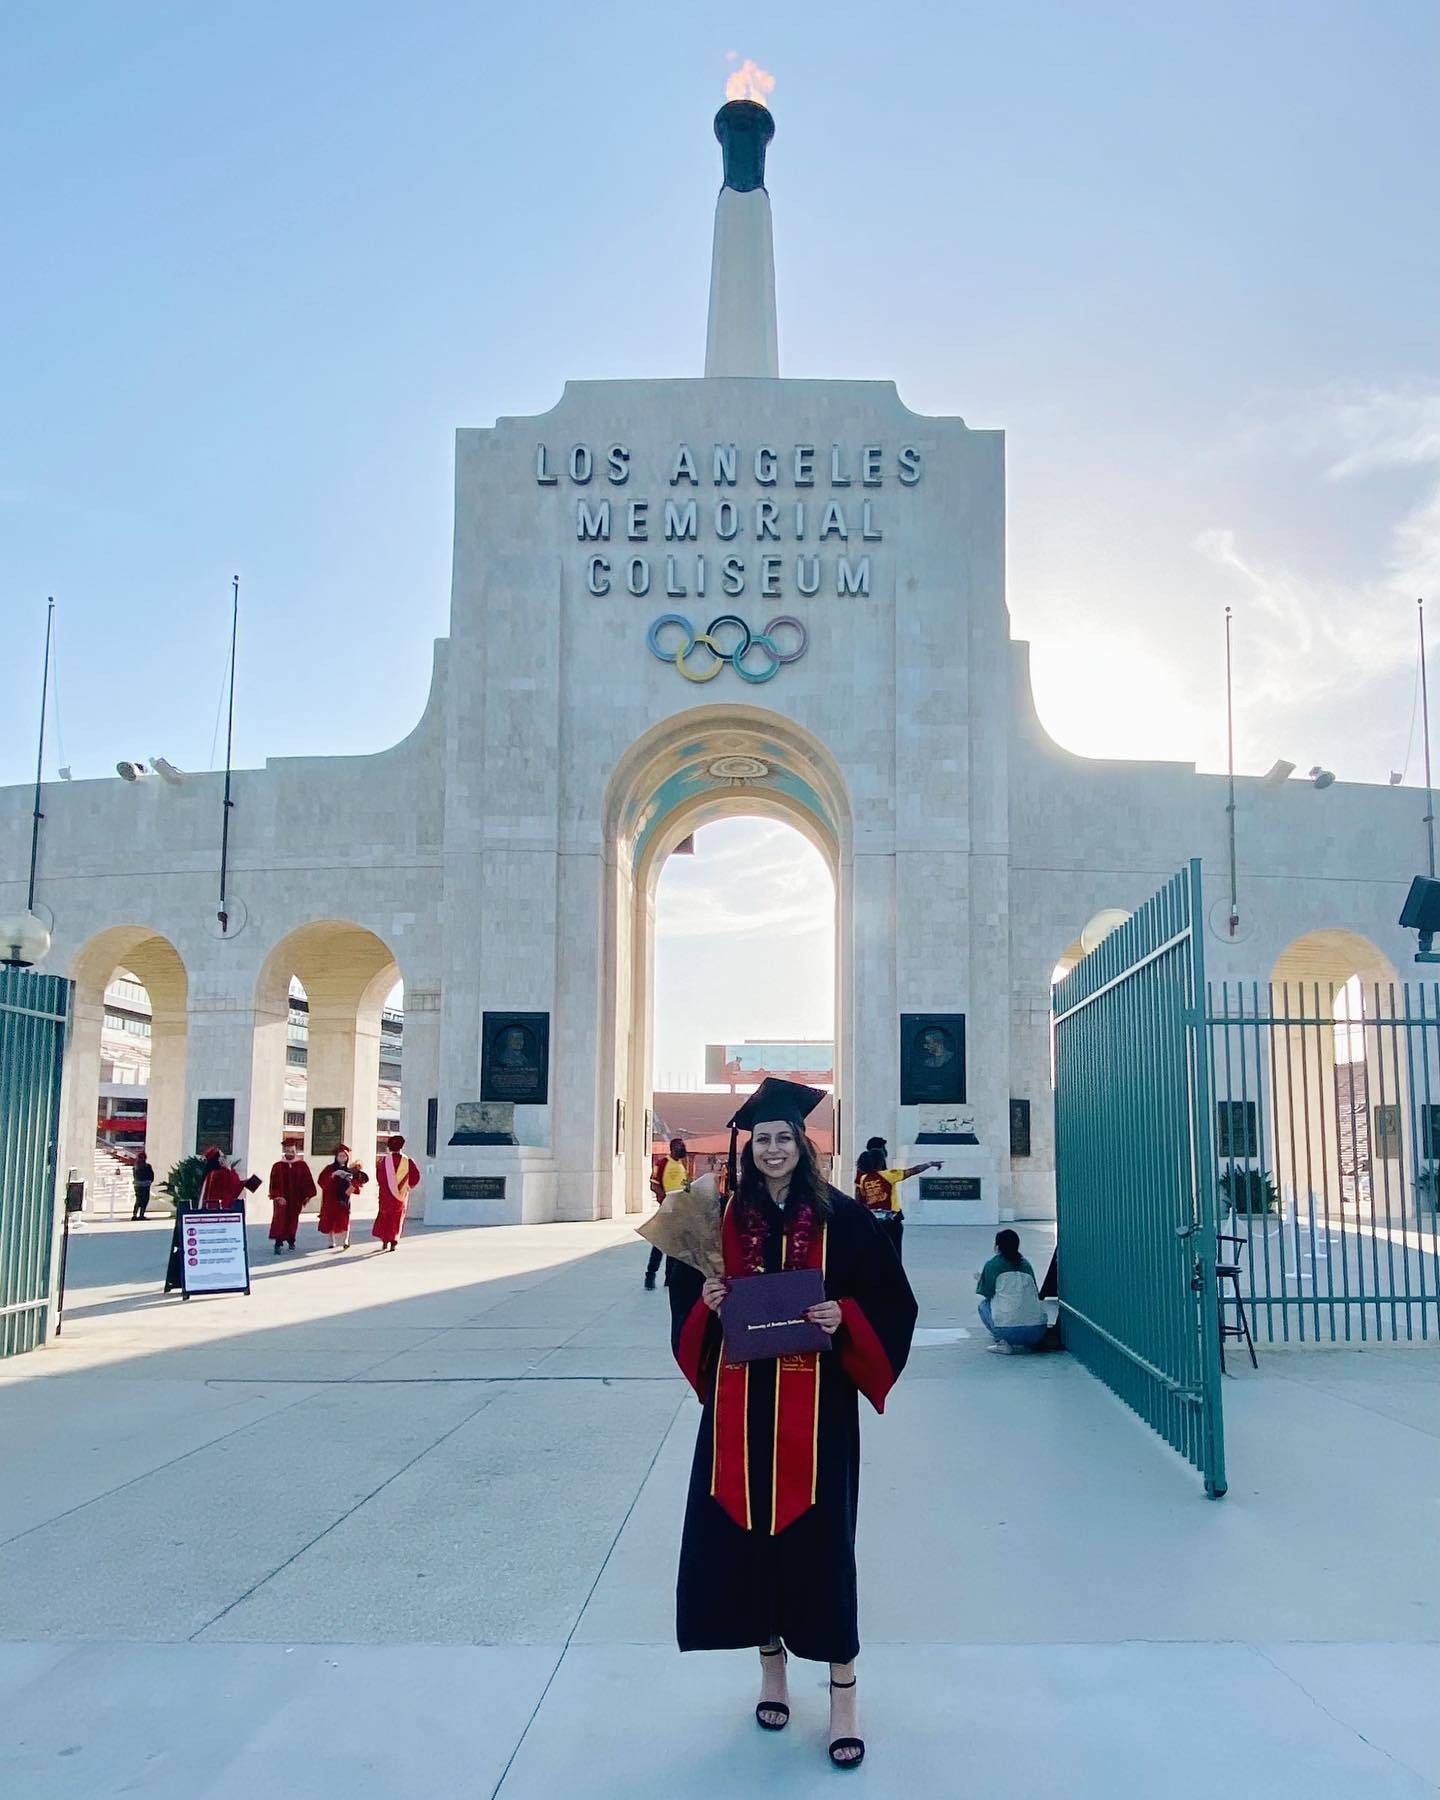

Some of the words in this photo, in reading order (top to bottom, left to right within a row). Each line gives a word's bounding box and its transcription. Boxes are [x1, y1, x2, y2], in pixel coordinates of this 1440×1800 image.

[536, 443, 630, 486] LOS
[669, 444, 920, 487] ANGELES
[576, 498, 883, 542] MEMORIAL
[588, 554, 870, 598] COLISEUM
